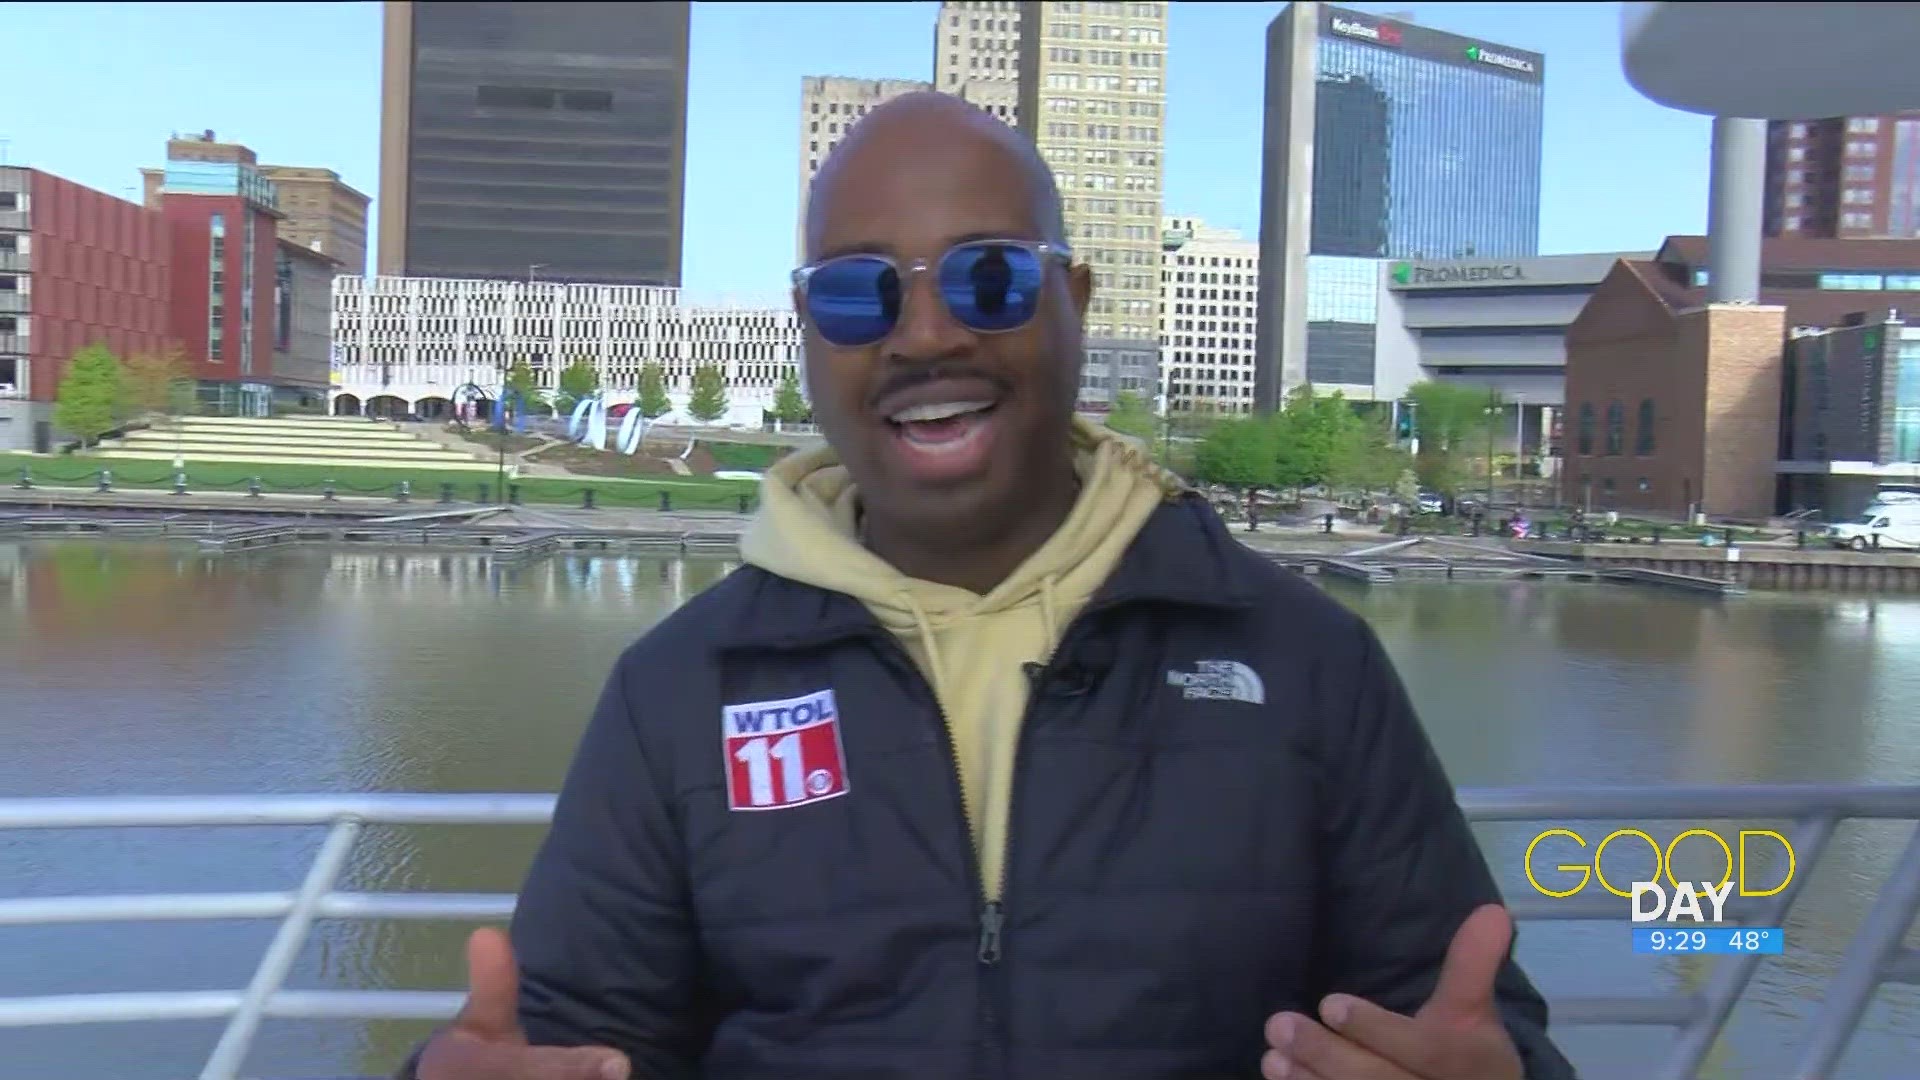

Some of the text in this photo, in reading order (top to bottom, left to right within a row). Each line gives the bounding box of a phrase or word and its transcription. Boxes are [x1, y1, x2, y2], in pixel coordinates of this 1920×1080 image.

[1414, 264, 1526, 283] PROMEDICA
[734, 699, 834, 732] WTOL
[734, 732, 807, 806] 11
